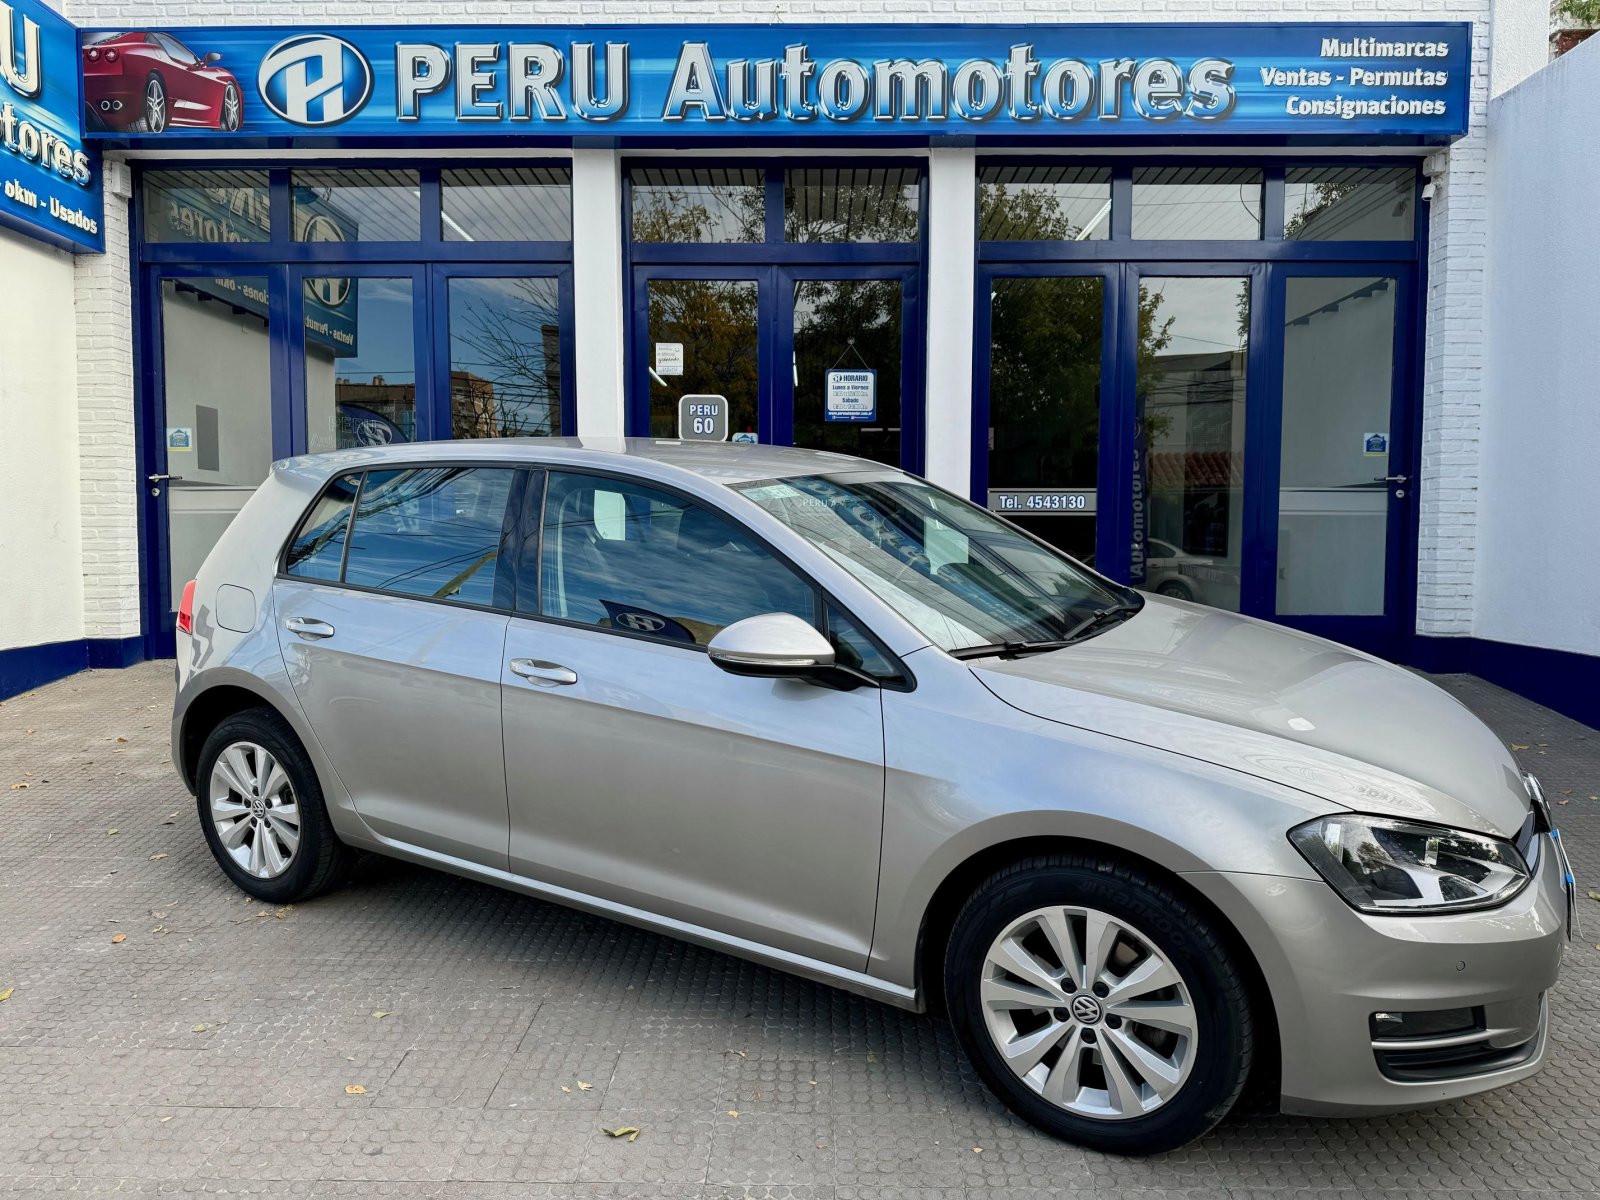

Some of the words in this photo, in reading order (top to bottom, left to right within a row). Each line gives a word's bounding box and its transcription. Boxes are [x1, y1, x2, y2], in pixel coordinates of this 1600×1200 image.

[1320, 37, 1449, 57] Multimarcas
[395, 41, 631, 122] PERU
[661, 41, 1237, 123] Automotores
[1260, 66, 1331, 86] Ventas
[1349, 66, 1448, 86] Permutas
[1286, 94, 1446, 119] Consignaciones
[0, 102, 91, 187] tores
[49, 195, 98, 235] Usados
[843, 374, 868, 382] HORARIO
[689, 404, 718, 416] PERU
[693, 417, 714, 434] 60
[1000, 495, 1022, 509] Tel.
[1026, 495, 1085, 509] 4543130
